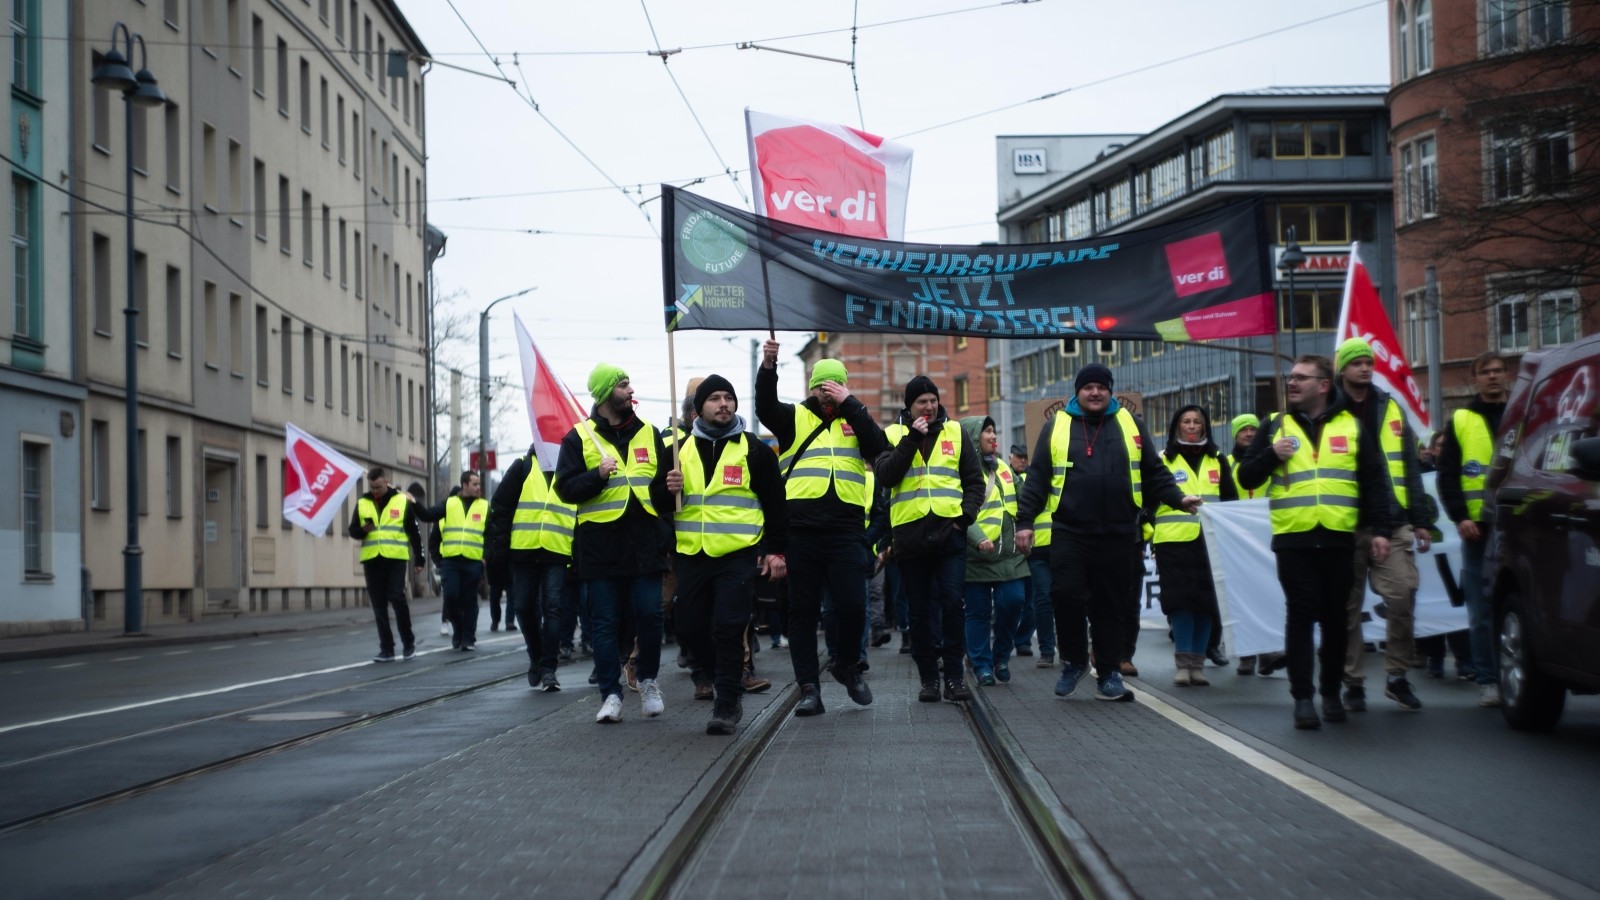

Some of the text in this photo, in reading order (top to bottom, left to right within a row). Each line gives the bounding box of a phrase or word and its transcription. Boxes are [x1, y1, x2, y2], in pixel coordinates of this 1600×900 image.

[770, 190, 876, 221] ver.di
[682, 210, 713, 240] FRIDAYS
[705, 250, 743, 272] FUTURE
[1176, 266, 1224, 285] ver.di
[703, 285, 745, 297] WEITER
[703, 296, 745, 308] KOMMEN
[906, 273, 1015, 306] JETZT
[845, 293, 1100, 334] FINANZIEREN
